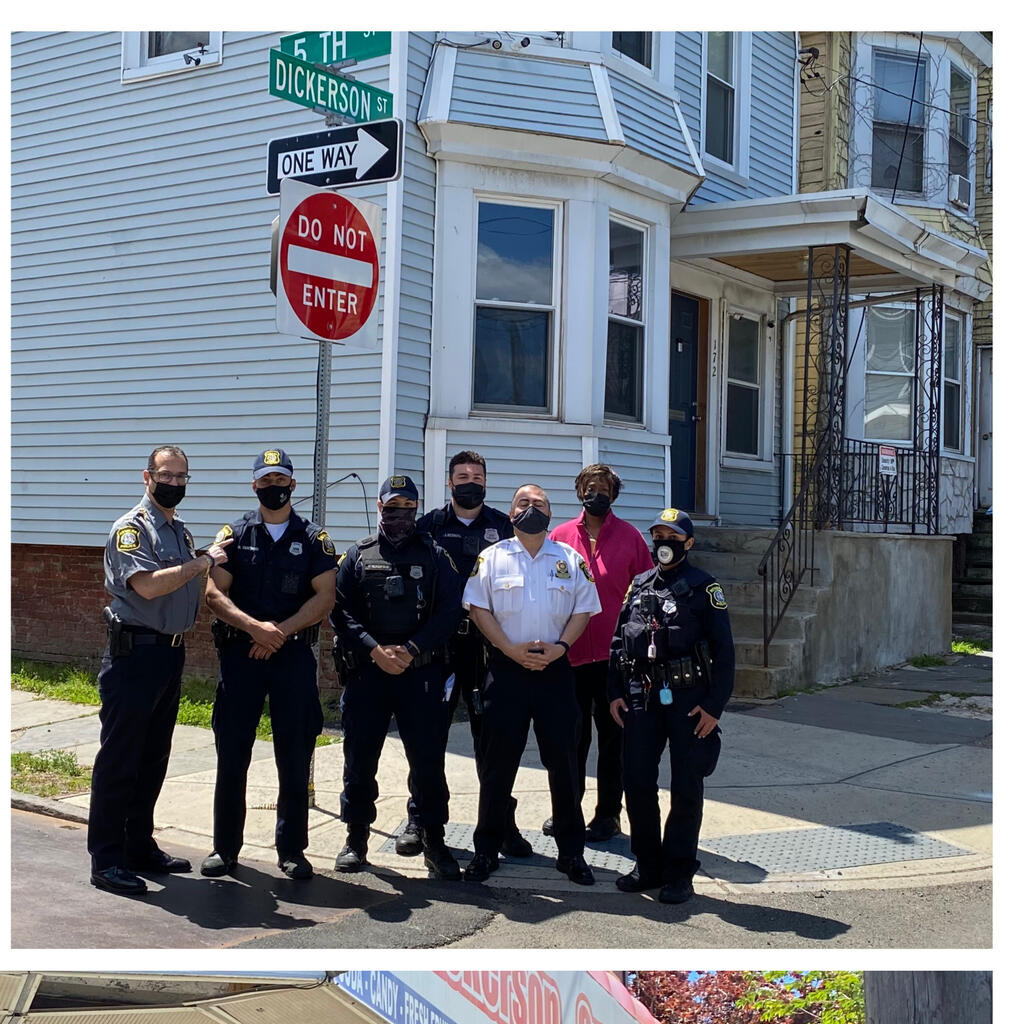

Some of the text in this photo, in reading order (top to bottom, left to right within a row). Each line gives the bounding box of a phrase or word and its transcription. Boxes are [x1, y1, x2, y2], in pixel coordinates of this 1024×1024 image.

[293, 31, 347, 64] 5 TH
[276, 59, 388, 121] DICKERSON ST
[281, 144, 357, 176] ONE WAY
[297, 214, 367, 252] DO NOT
[302, 283, 358, 316] ENTER
[370, 971, 399, 1020] CANDY
